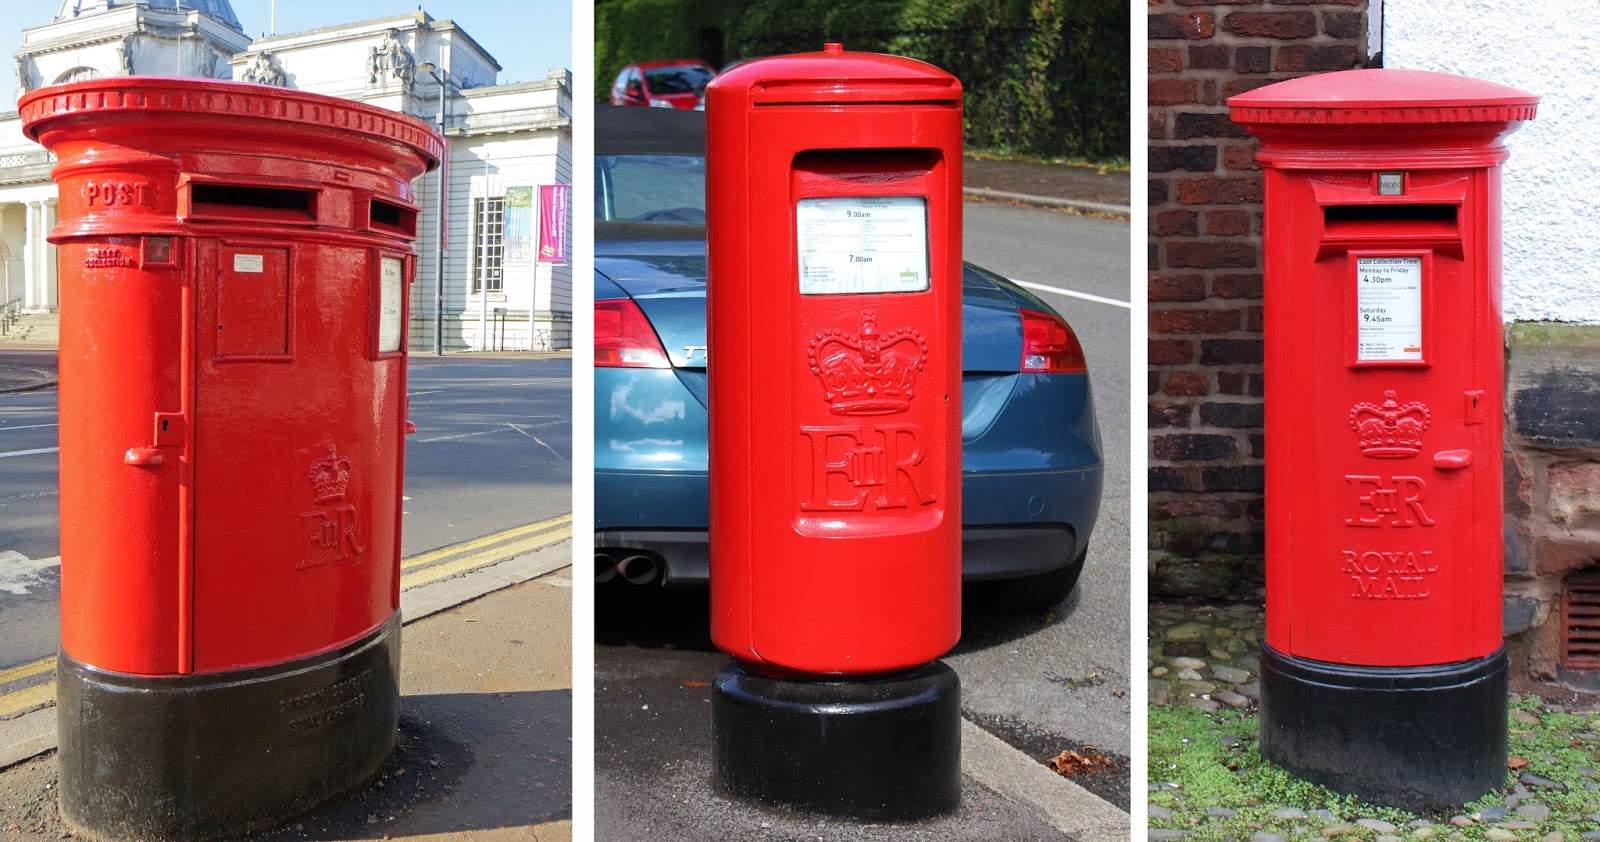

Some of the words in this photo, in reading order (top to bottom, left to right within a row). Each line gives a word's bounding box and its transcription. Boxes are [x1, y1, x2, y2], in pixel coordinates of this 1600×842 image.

[1380, 181, 1400, 189] MON
[86, 181, 149, 207] POST
[846, 210, 871, 218] 9.00am
[85, 258, 132, 269] COLLECTION
[849, 255, 873, 263] 7.00am
[1363, 275, 1392, 284] 4.30pm
[1363, 314, 1392, 322] 9.45am
[1342, 550, 1439, 574] ROYAL
[1351, 575, 1430, 599] MAIL
